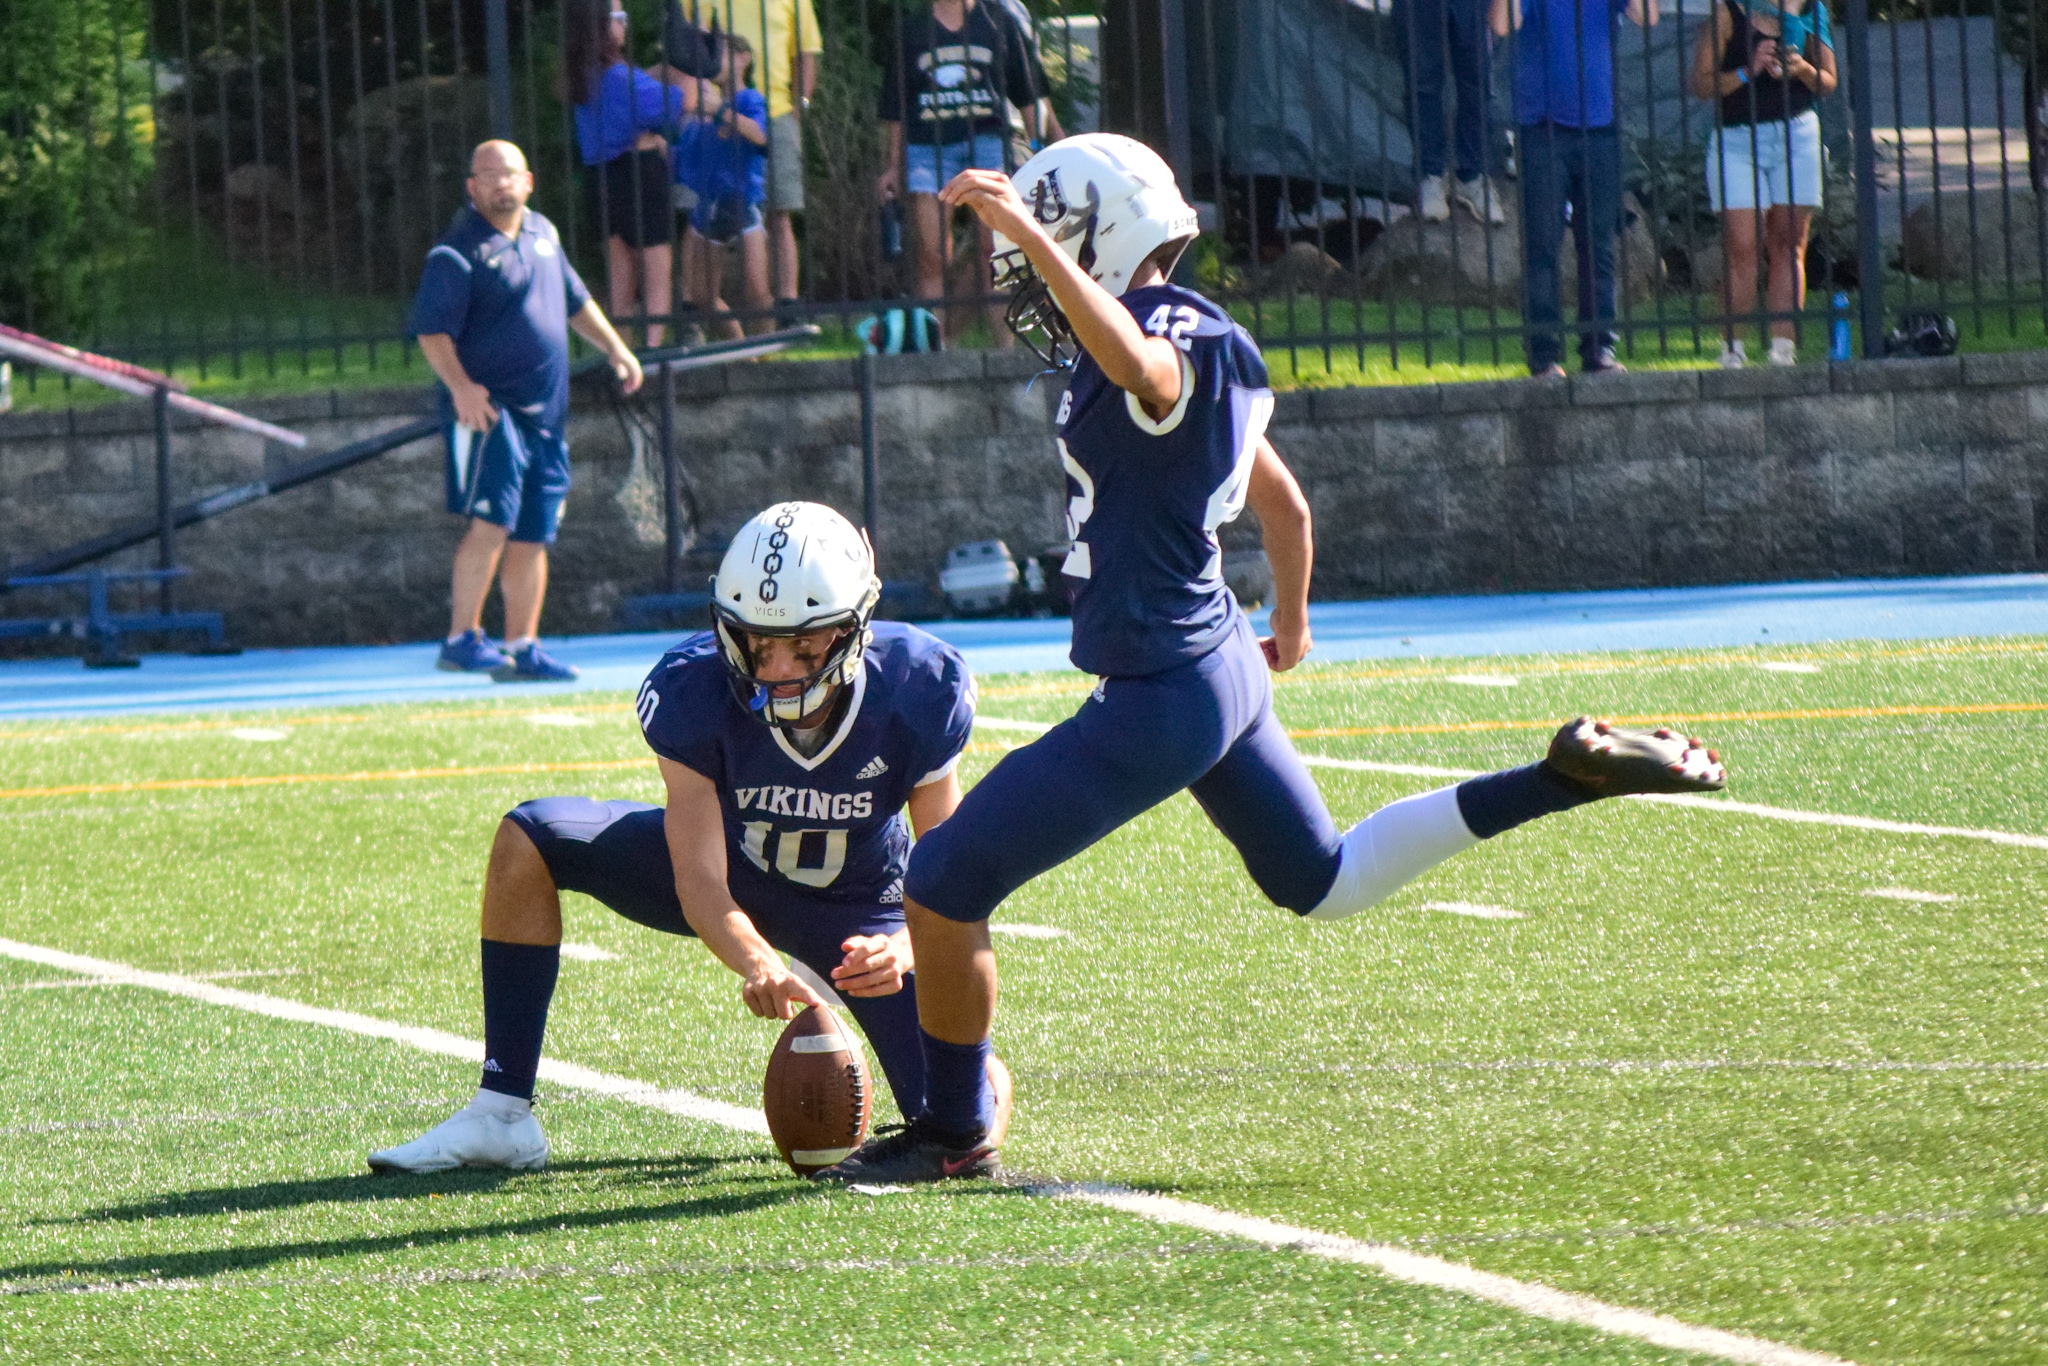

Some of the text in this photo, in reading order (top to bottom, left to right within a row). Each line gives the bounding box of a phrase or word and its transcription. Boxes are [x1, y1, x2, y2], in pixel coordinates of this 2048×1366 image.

[1145, 303, 1200, 351] 42
[755, 606, 786, 617] VICIS
[856, 765, 889, 780] adidas
[735, 785, 873, 820] VIKINGS
[739, 820, 849, 888] 10
